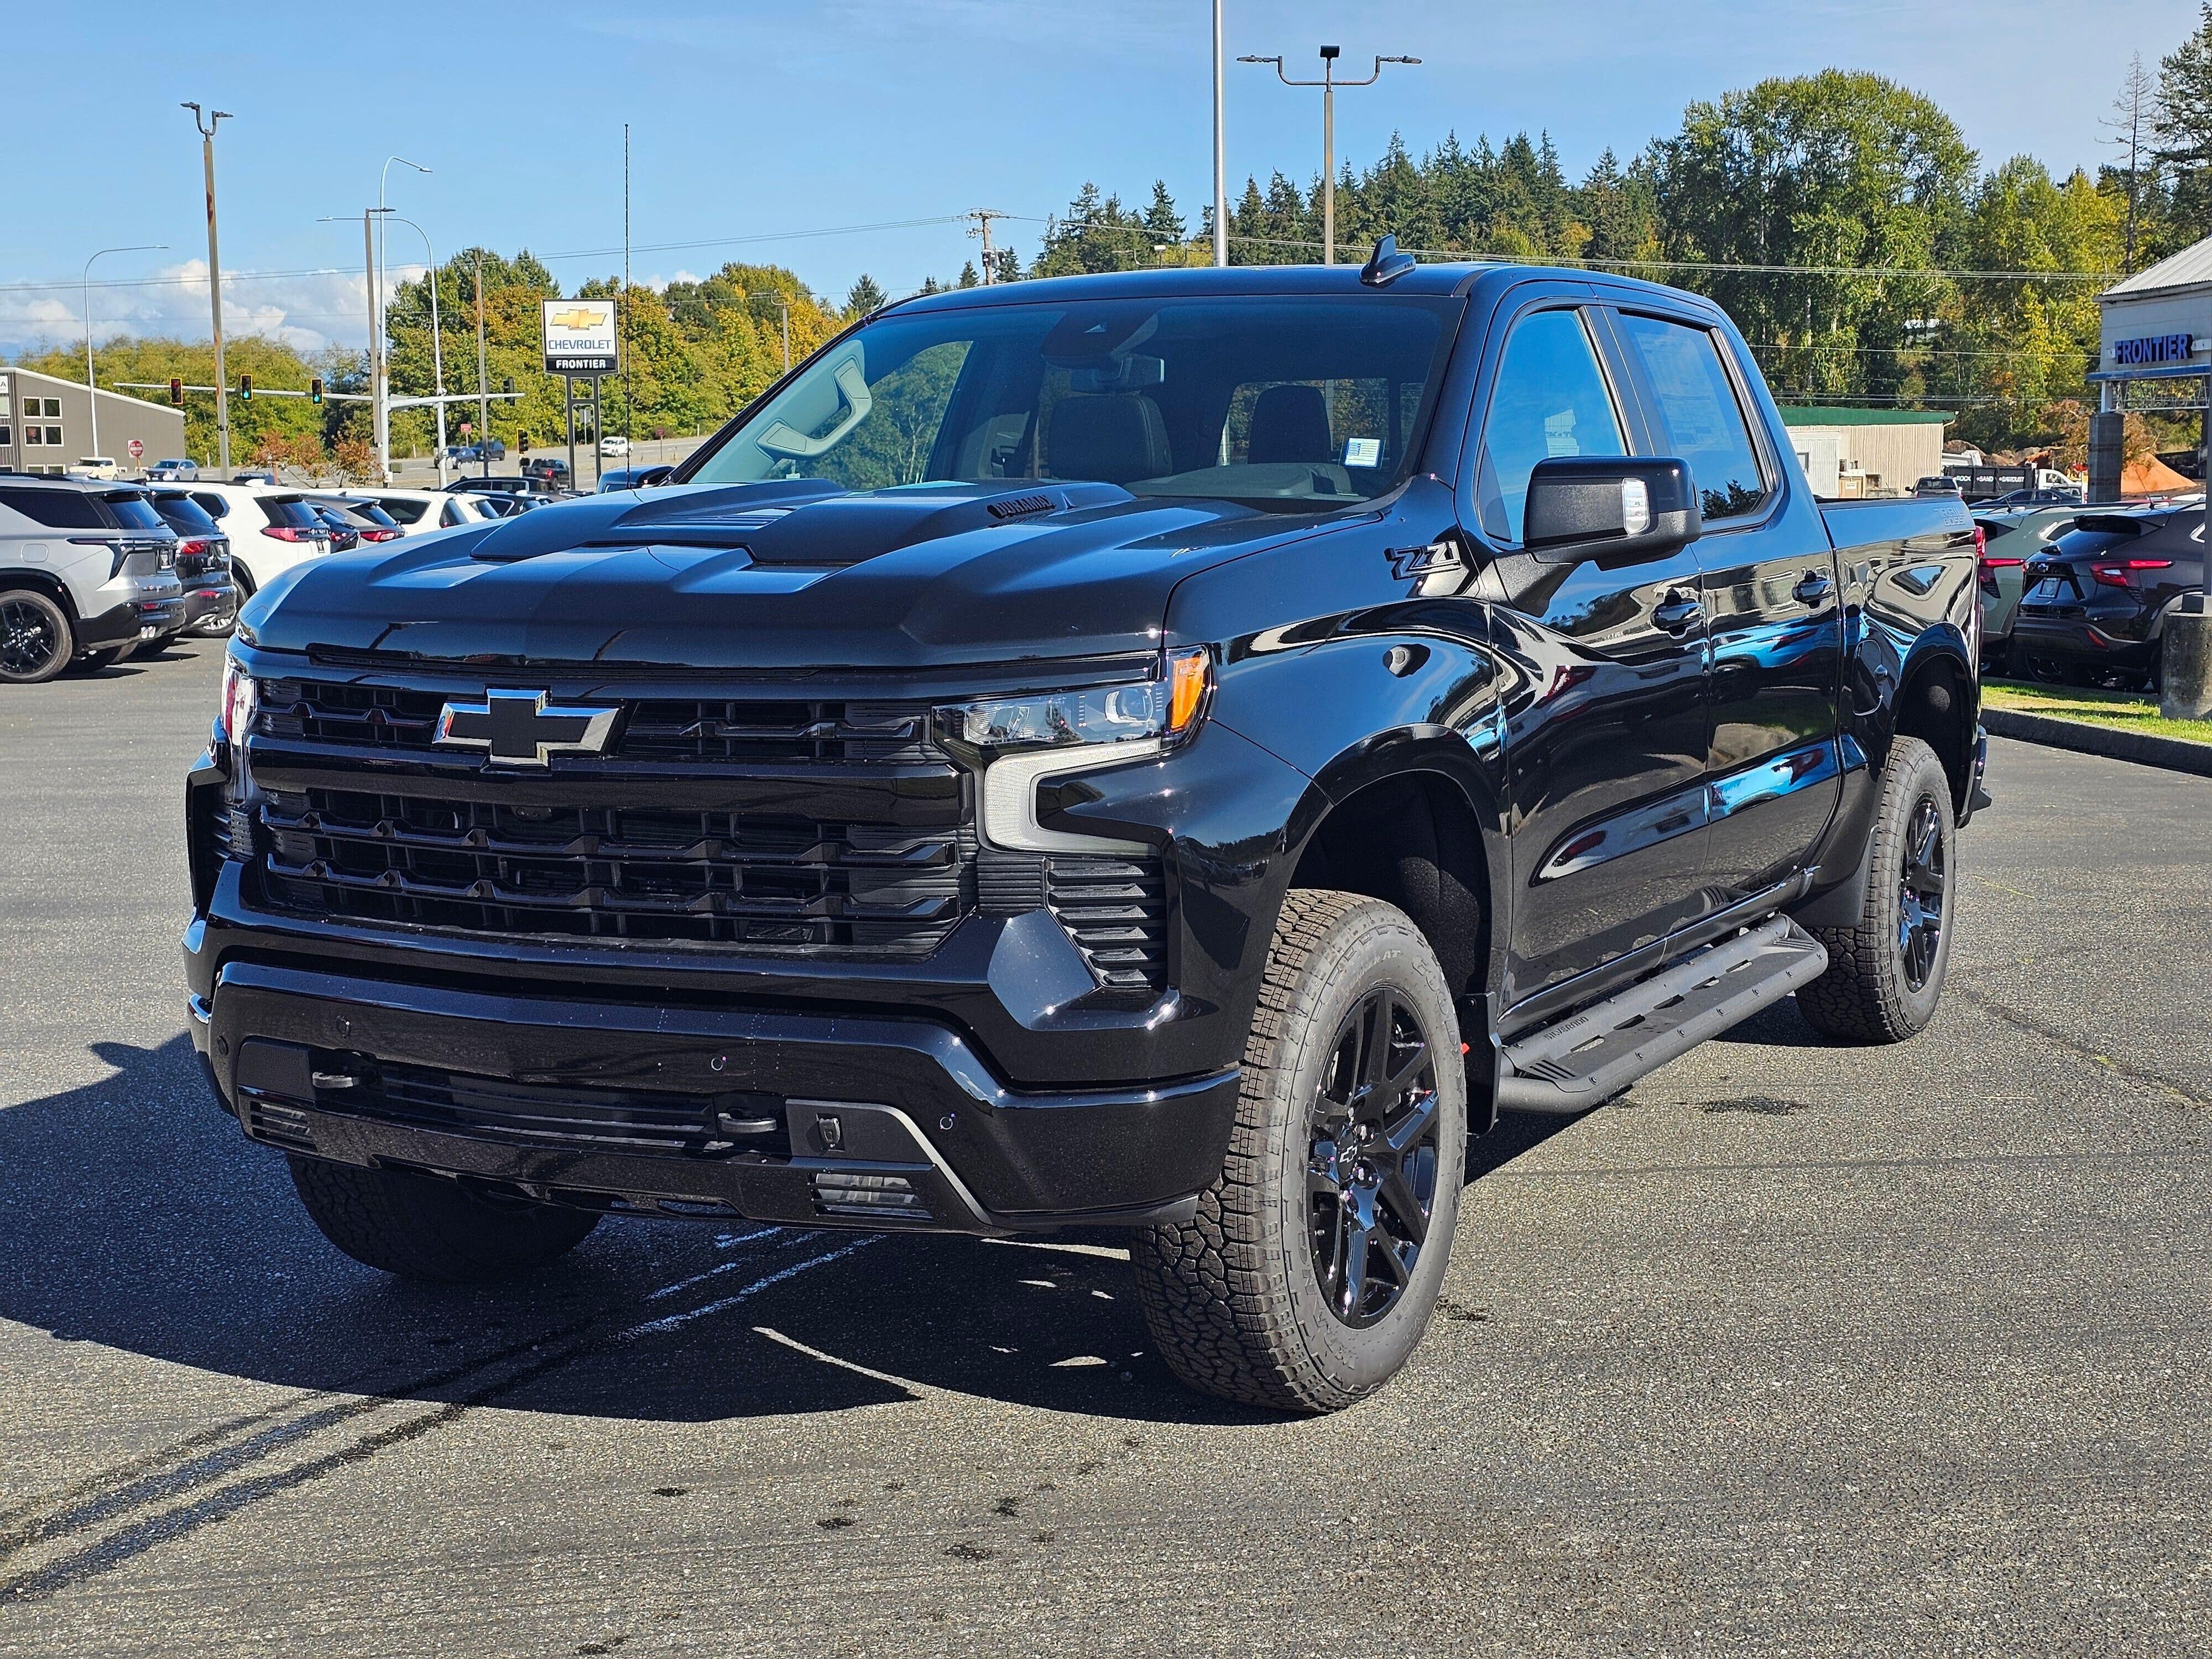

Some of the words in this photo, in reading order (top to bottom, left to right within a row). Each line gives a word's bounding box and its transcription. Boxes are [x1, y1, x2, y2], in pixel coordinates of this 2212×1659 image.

[549, 340, 611, 349] CHEVROLET
[2115, 333, 2189, 364] FRONTIER
[556, 359, 606, 369] FRONTIER
[1943, 516, 1965, 526] BOSS
[1384, 540, 1463, 581] Z71
